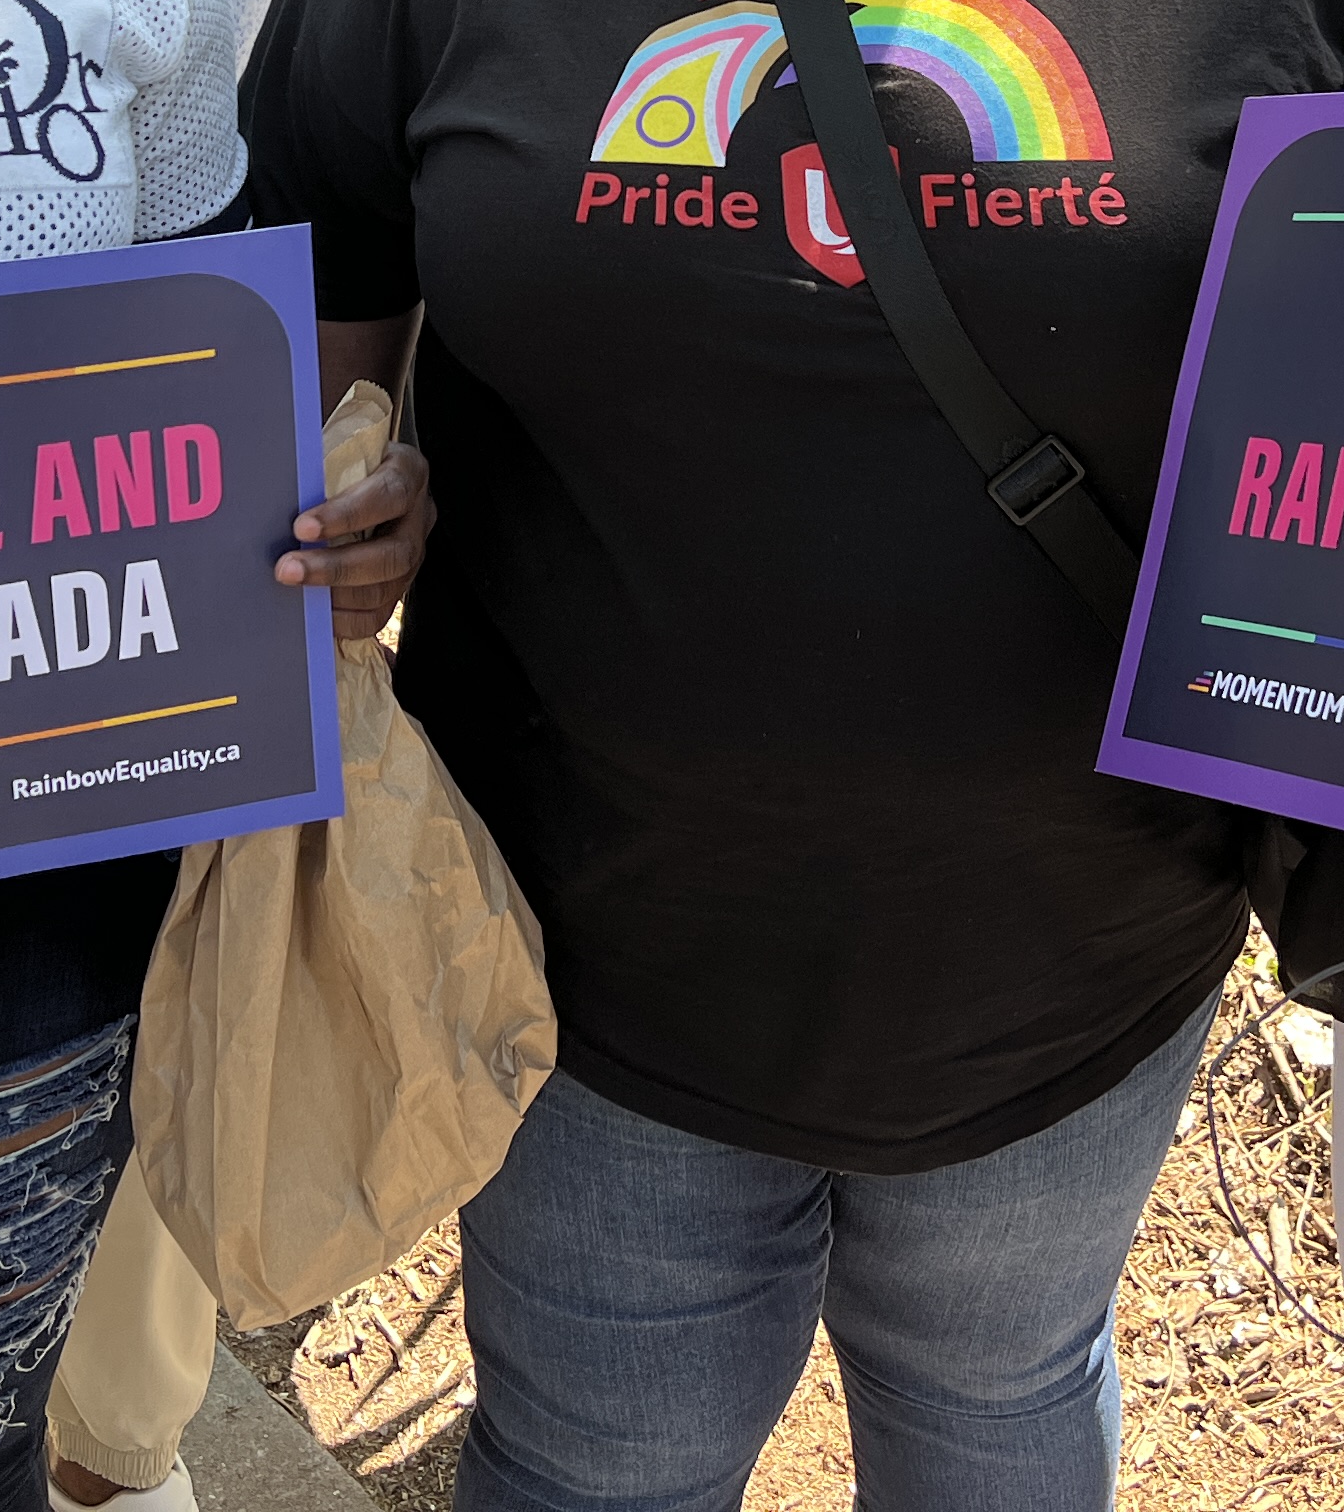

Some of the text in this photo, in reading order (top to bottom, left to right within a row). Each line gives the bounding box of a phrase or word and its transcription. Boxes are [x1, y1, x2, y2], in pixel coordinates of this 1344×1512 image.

[575, 171, 758, 229] Pride
[920, 172, 1128, 229] Fierté
[30, 423, 223, 544] AND
[12, 744, 241, 800] RainbowEquality.ca
